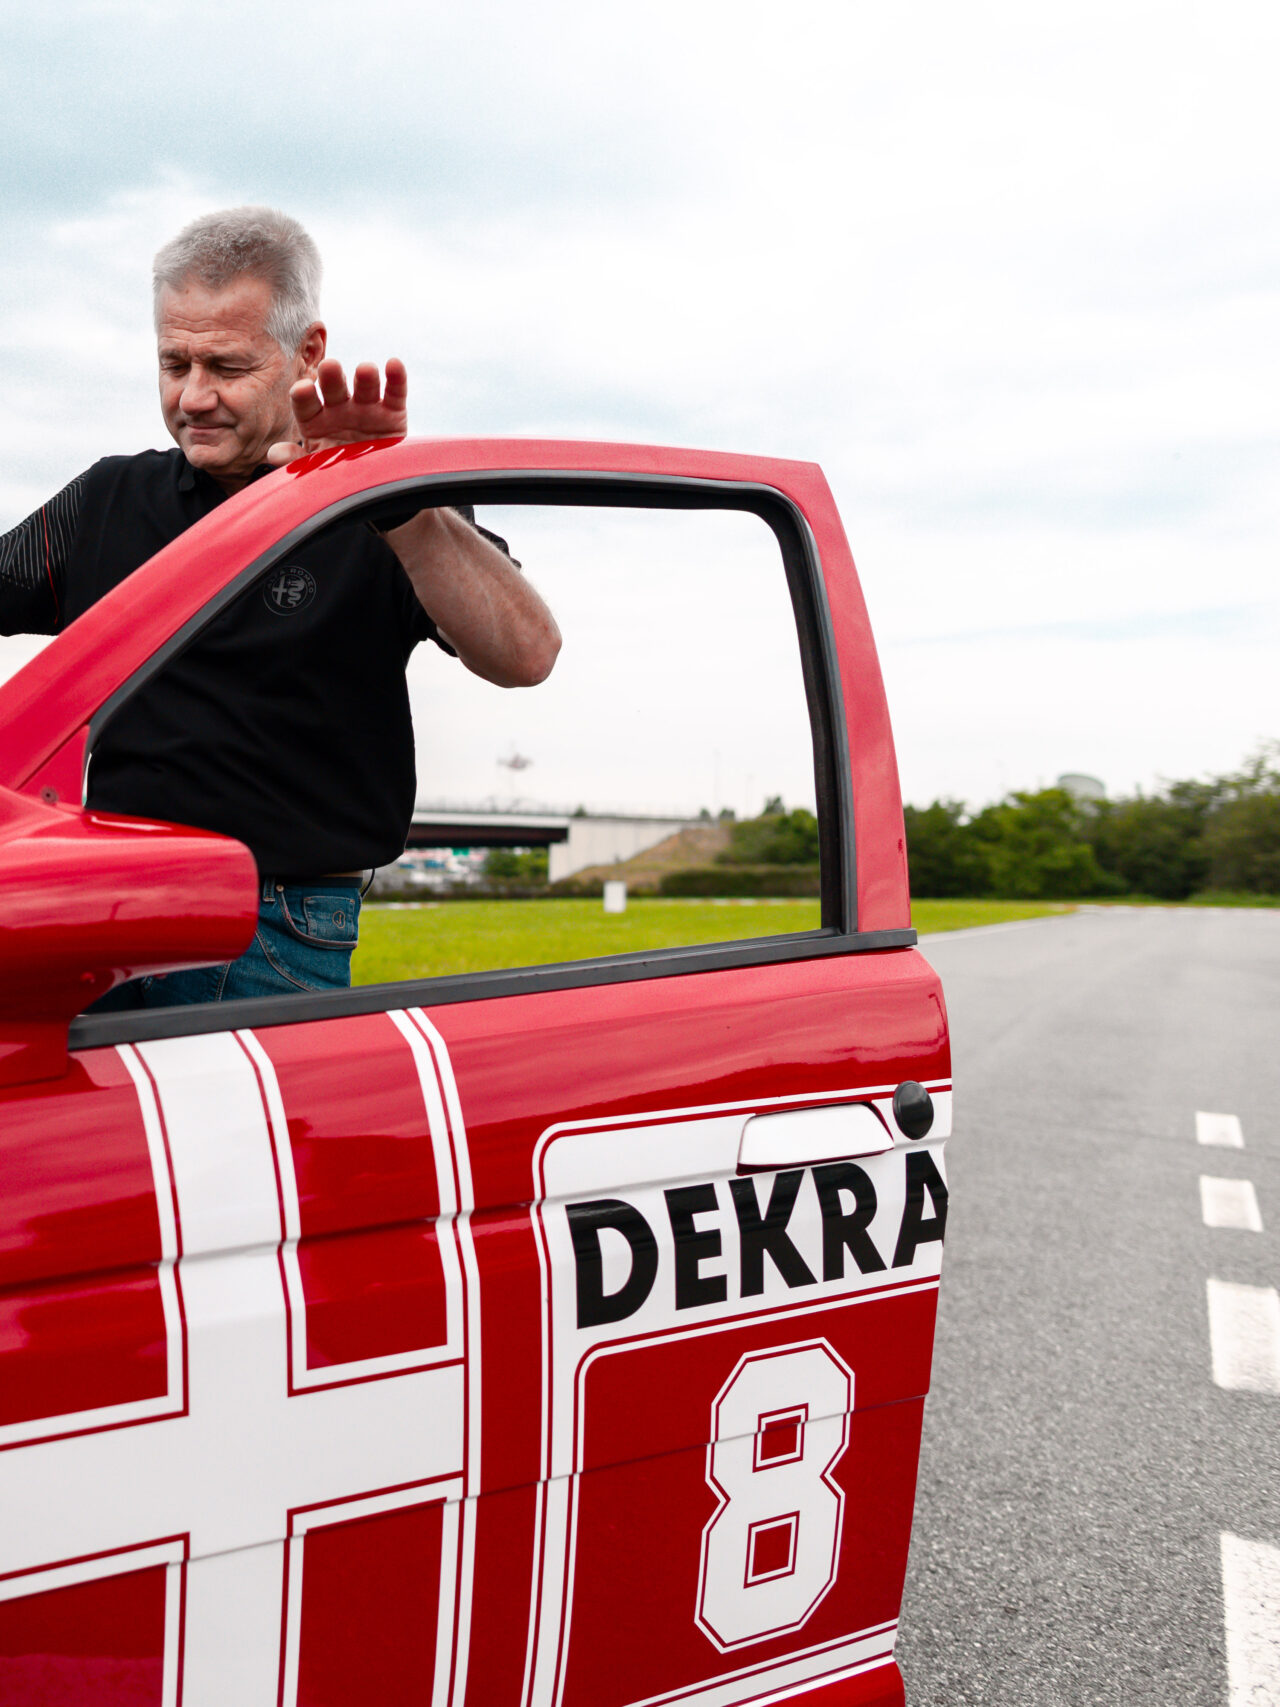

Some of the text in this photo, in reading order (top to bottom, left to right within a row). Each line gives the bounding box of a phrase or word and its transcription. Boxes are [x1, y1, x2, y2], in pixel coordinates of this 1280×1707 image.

[289, 568, 314, 594] ROMEO
[565, 1150, 949, 1329] DEKRA
[695, 1337, 855, 1654] 8
